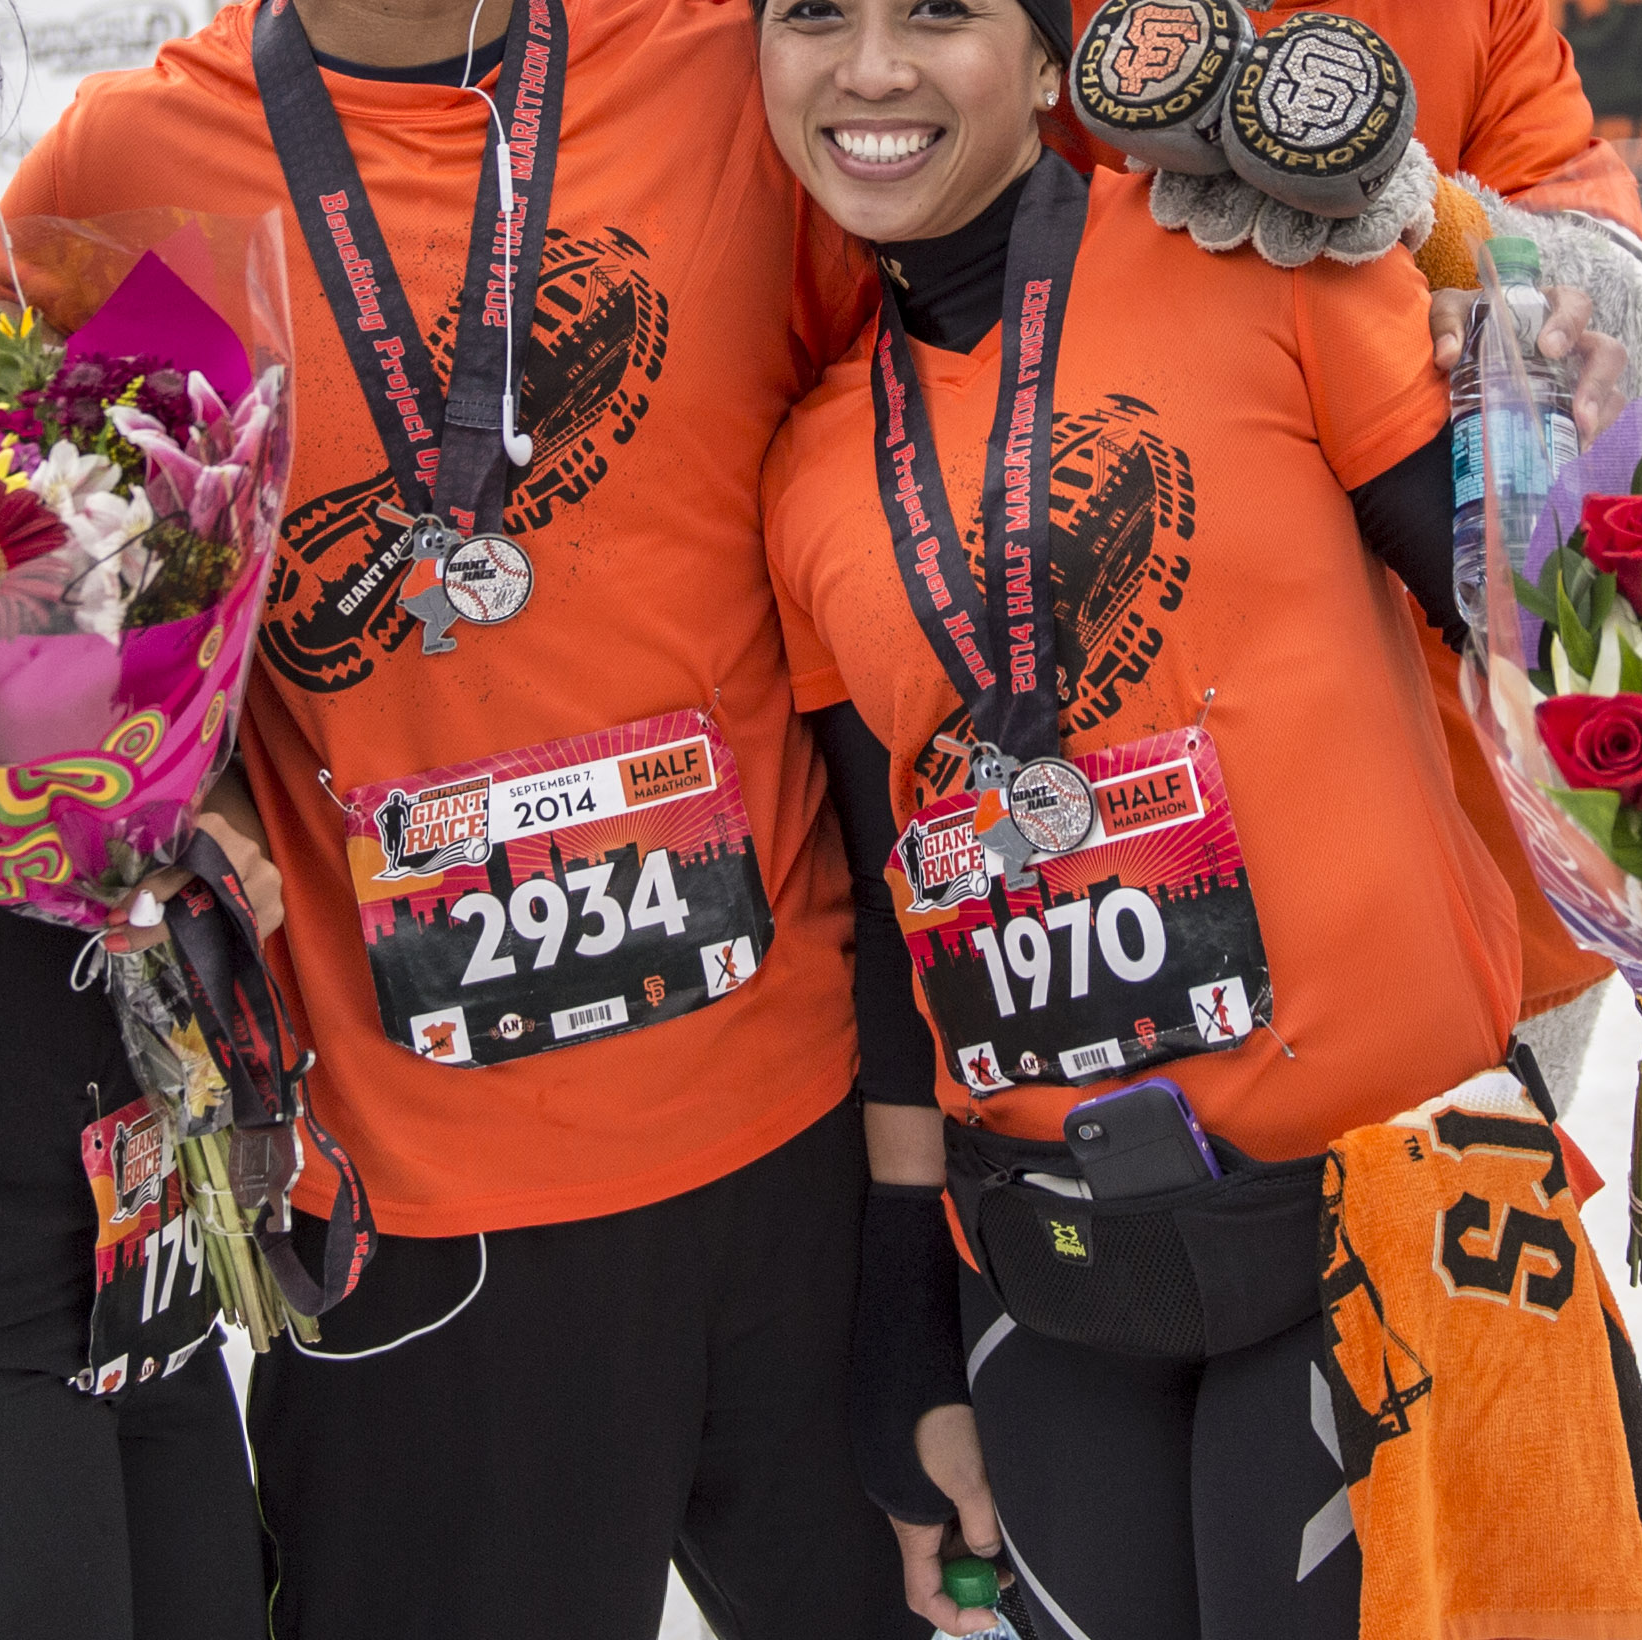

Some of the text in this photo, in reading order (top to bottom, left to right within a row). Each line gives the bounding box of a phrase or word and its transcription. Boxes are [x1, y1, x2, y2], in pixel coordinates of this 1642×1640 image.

[1079, 38, 1225, 124] CHAMPIONS
[508, 40, 551, 181] MARATHON
[1236, 62, 1390, 171] CHAMPIONS
[318, 189, 388, 332] Benefiting
[373, 335, 433, 442] Project
[1004, 278, 1053, 696] 2014 HALF MARATHON FINISHER
[448, 559, 490, 573] GIANT
[461, 568, 498, 582] RACE
[893, 441, 932, 537] Project
[914, 536, 953, 611] Open
[943, 610, 998, 691] Hand
[336, 567, 387, 616] GIANT
[508, 770, 594, 799] SEPTEMBER 7,
[628, 747, 698, 787] HALF
[634, 772, 703, 801] MARATHON
[410, 790, 487, 827] GIANT
[419, 788, 441, 802] SAN
[440, 778, 490, 797] FRANCISCO
[513, 787, 598, 830] 2014
[1012, 785, 1049, 803] GIANT
[1027, 793, 1059, 811] RACE
[1106, 772, 1182, 815] HALF
[404, 813, 487, 856] RACE
[1112, 800, 1188, 830] MARATHON
[921, 845, 983, 886] RACE
[450, 849, 690, 986] 2934
[971, 887, 1167, 1018] 1970
[1404, 1135, 1425, 1162] TM
[123, 1148, 162, 1194] RACE
[141, 1205, 214, 1324] 179
